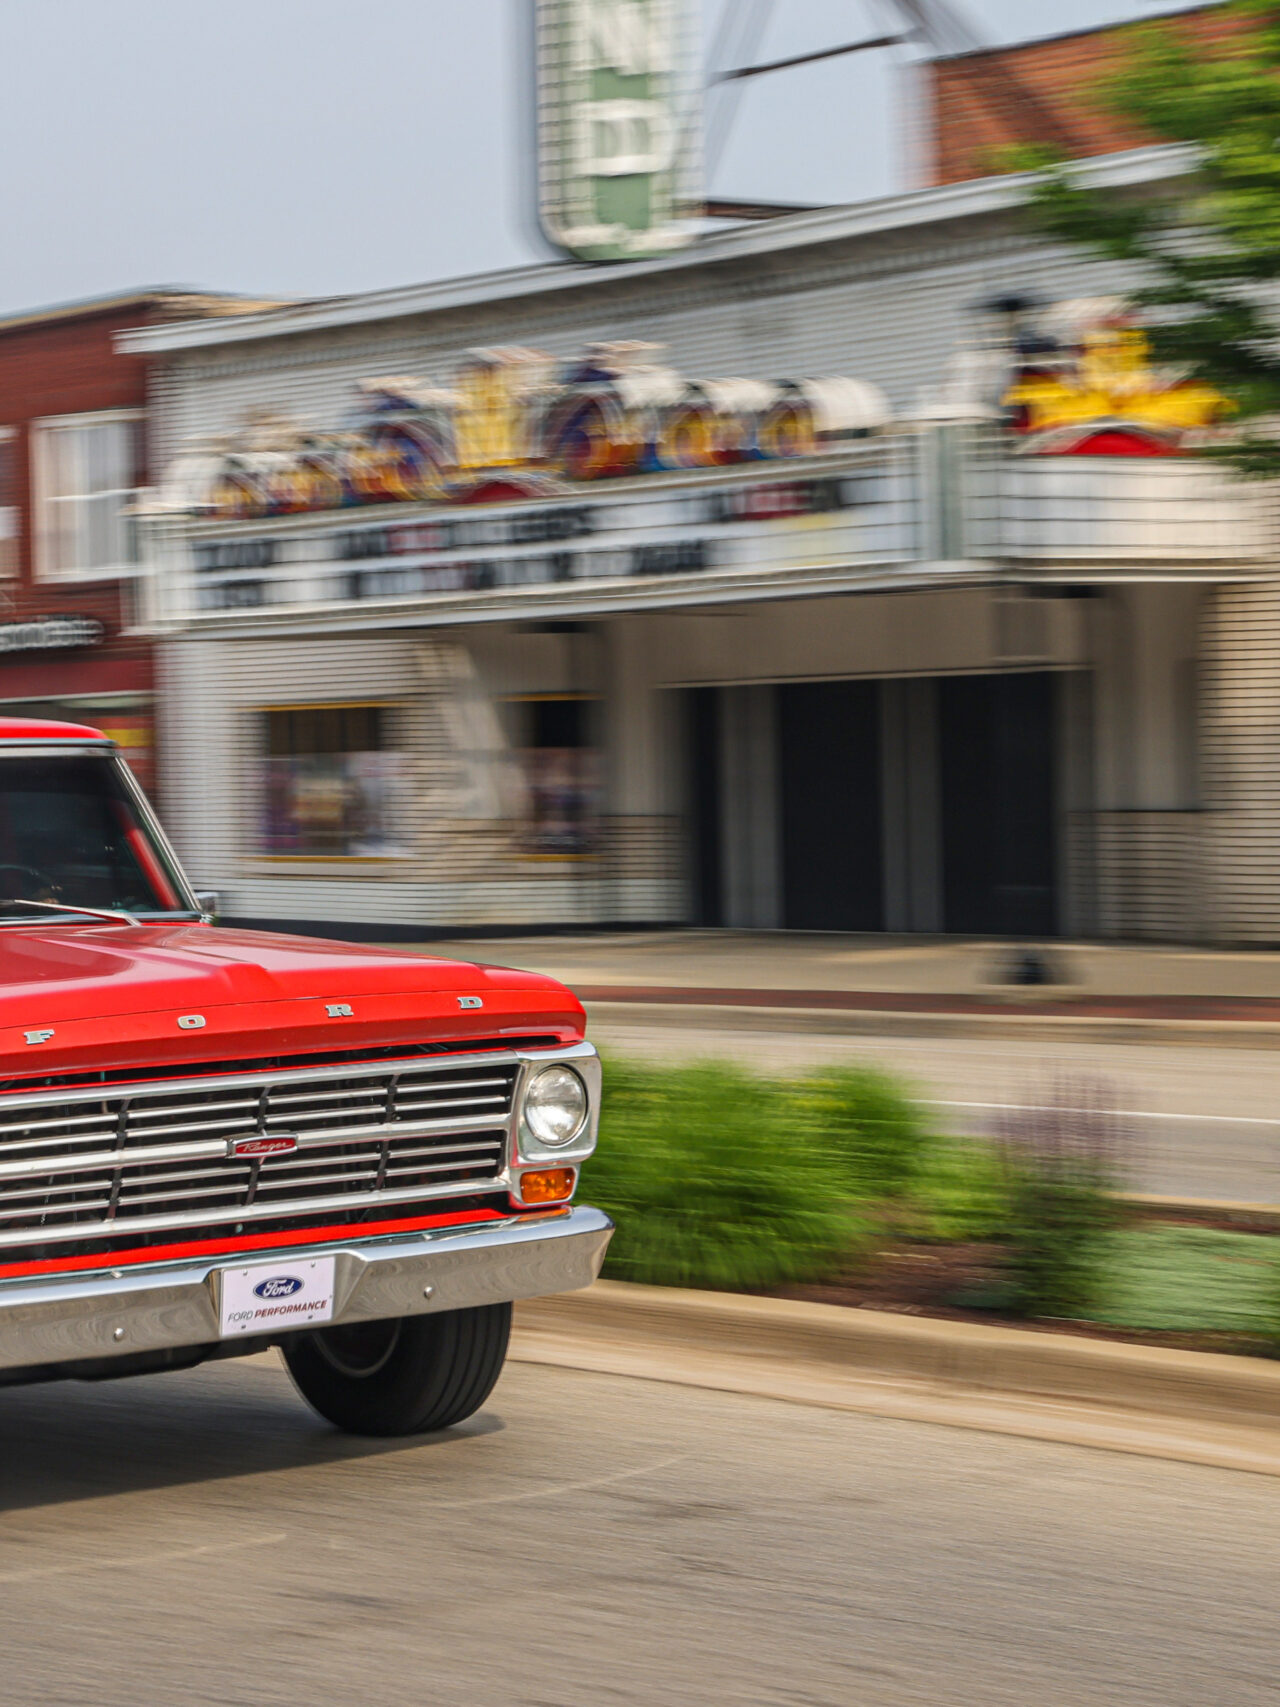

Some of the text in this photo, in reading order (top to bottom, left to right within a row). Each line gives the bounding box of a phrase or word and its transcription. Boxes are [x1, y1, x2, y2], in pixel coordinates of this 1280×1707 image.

[23, 995, 484, 1046] FORD
[237, 1141, 292, 1152] Ranger
[261, 1279, 295, 1297] Ford
[227, 1300, 328, 1322] FORD PERFORMANCE
